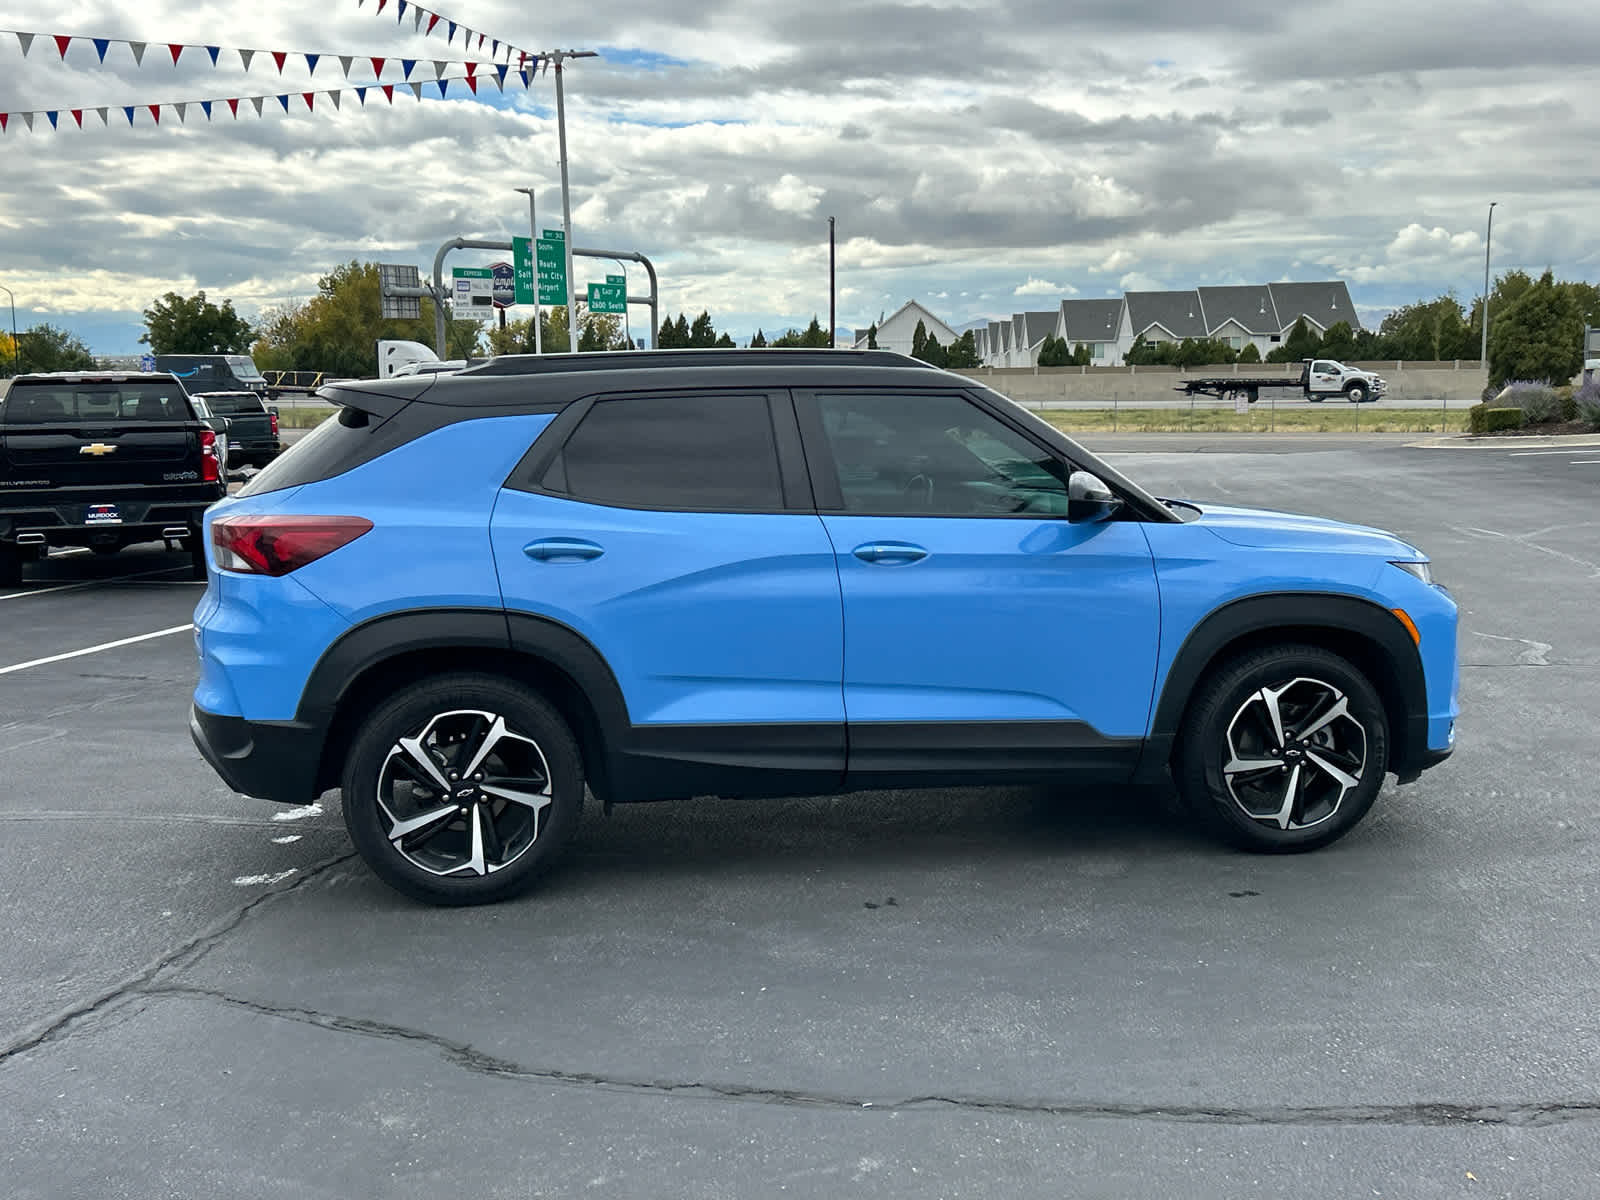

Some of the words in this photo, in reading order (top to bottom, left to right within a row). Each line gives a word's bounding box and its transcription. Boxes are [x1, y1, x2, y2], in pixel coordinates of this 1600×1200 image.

[518, 269, 532, 278] Salt
[550, 271, 564, 281] City
[538, 282, 559, 292] Airport
[608, 301, 625, 309] South
